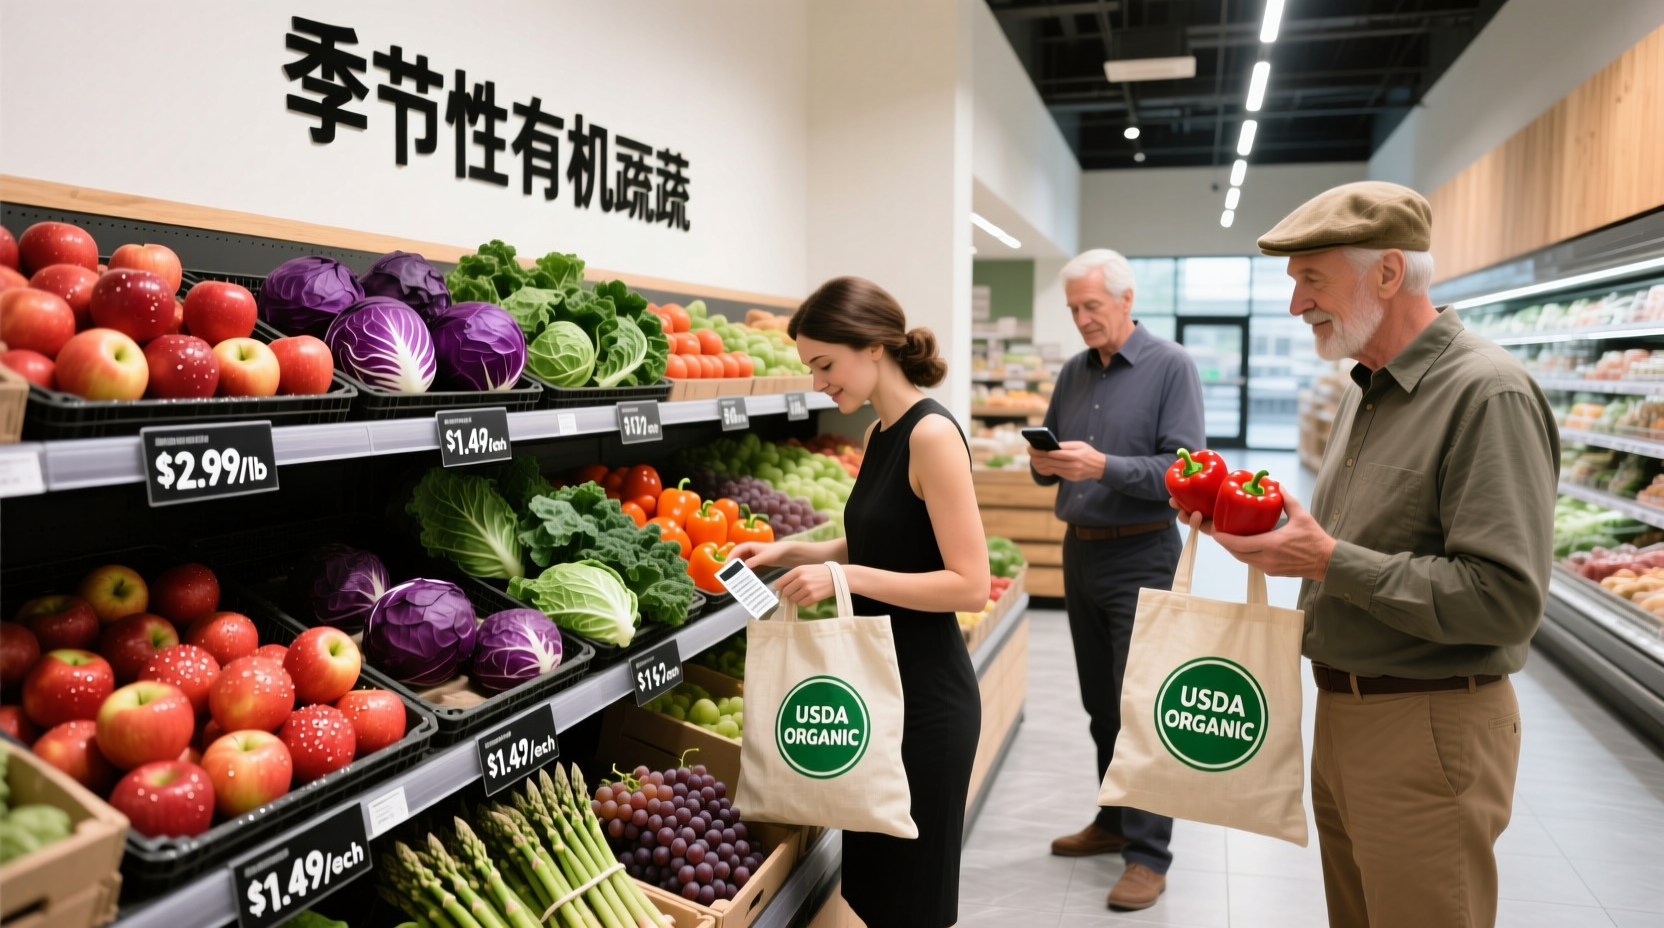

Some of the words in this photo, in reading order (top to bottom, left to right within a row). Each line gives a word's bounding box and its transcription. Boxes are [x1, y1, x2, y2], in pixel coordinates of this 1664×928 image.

[155, 447, 268, 491] $2.99/lb
[795, 705, 849, 725] USDA
[1180, 685, 1246, 717] USDA
[783, 727, 860, 747] ORGANIC
[1164, 709, 1255, 741] ORGANIC
[247, 841, 364, 918] $1.49/ech
